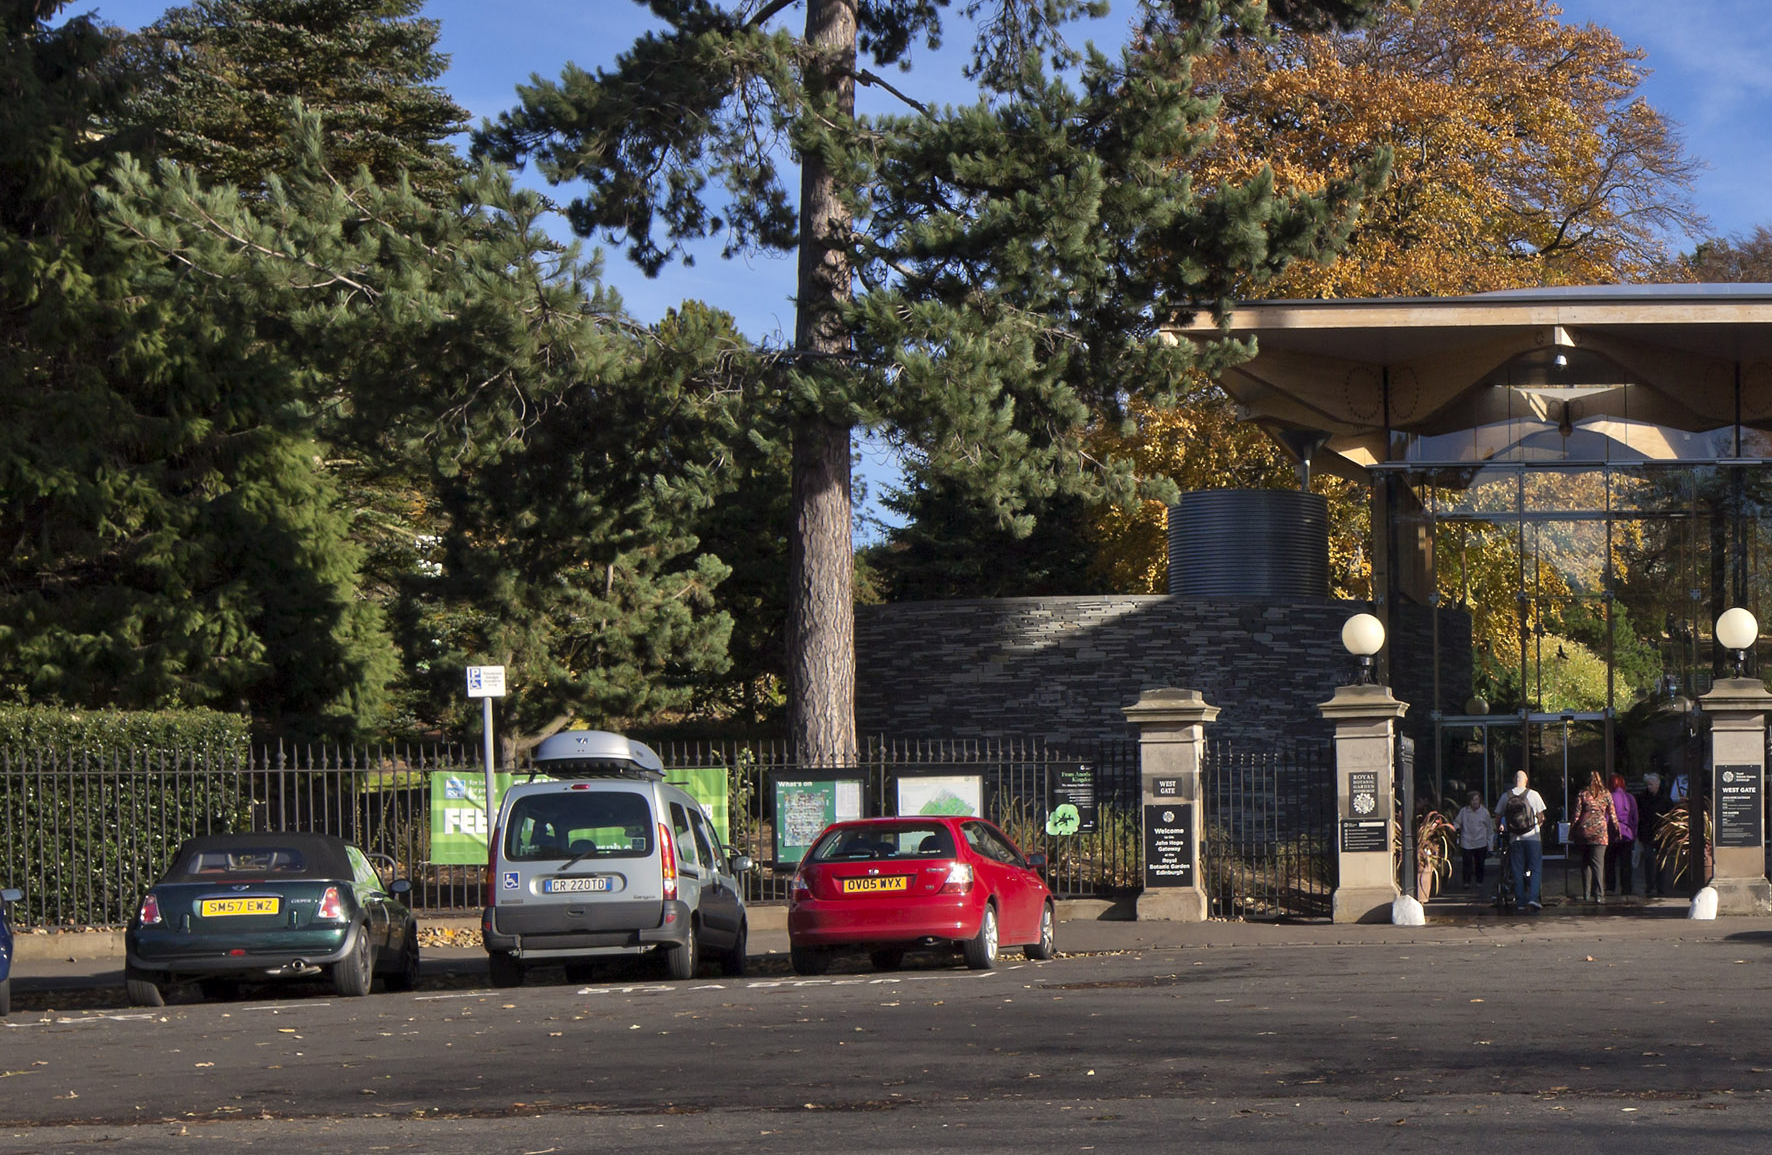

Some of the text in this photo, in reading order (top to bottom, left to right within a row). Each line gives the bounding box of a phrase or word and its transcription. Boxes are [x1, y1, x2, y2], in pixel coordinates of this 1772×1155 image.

[445, 808, 487, 834] FEE
[553, 880, 566, 891] CR
[848, 878, 902, 890] OV05 WYX
[209, 901, 272, 913] SM57 EWZ
